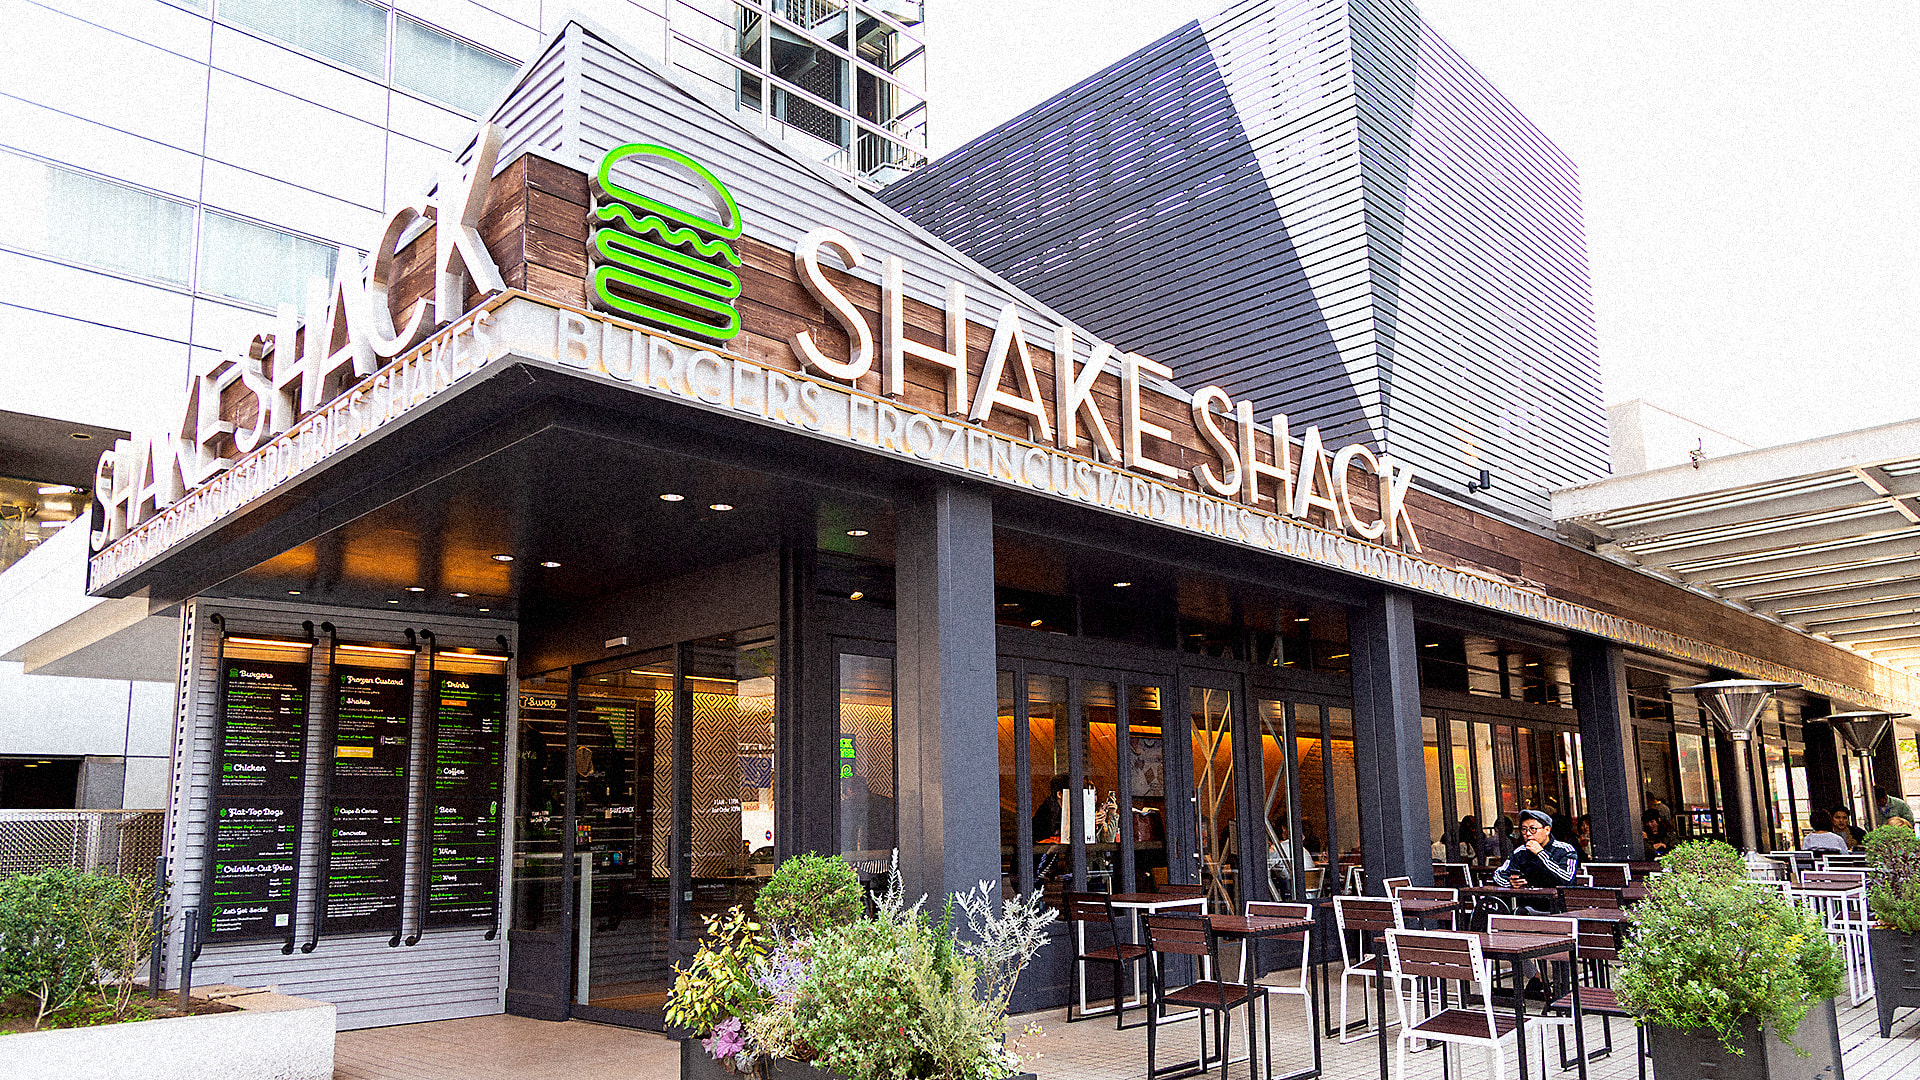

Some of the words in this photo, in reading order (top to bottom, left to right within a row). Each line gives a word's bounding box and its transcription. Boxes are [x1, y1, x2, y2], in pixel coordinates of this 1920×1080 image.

[91, 360, 235, 551] SHAKE
[234, 122, 509, 454] SHACK
[299, 391, 364, 471] FRIES
[370, 309, 492, 428] SHAKES
[789, 226, 1179, 480] SHAKE
[1191, 385, 1422, 554] SHACK
[558, 308, 826, 432] BURGERS
[850, 394, 1016, 484] FROZEN
[1023, 446, 1169, 521] CUSTARD
[1182, 491, 1255, 543] FRIES
[1262, 516, 1348, 568] SHAKES
[1355, 542, 1401, 581] HOT
[1402, 556, 1450, 595] DOGS
[1455, 572, 1545, 619] CONCRETES
[239, 669, 274, 680] Burgers
[346, 675, 374, 685] Frozen
[374, 676, 404, 686] Custard
[446, 680, 470, 689] Drinks
[346, 697, 371, 706] Shakes
[527, 697, 557, 709] Swag
[233, 763, 267, 772] Chicken
[443, 767, 465, 776] Coffee
[228, 807, 263, 817] Flat-Top
[262, 807, 284, 817] Dogs
[438, 847, 457, 855] Wine
[223, 864, 272, 873] Crinkle-Cut
[272, 864, 294, 873] Fries
